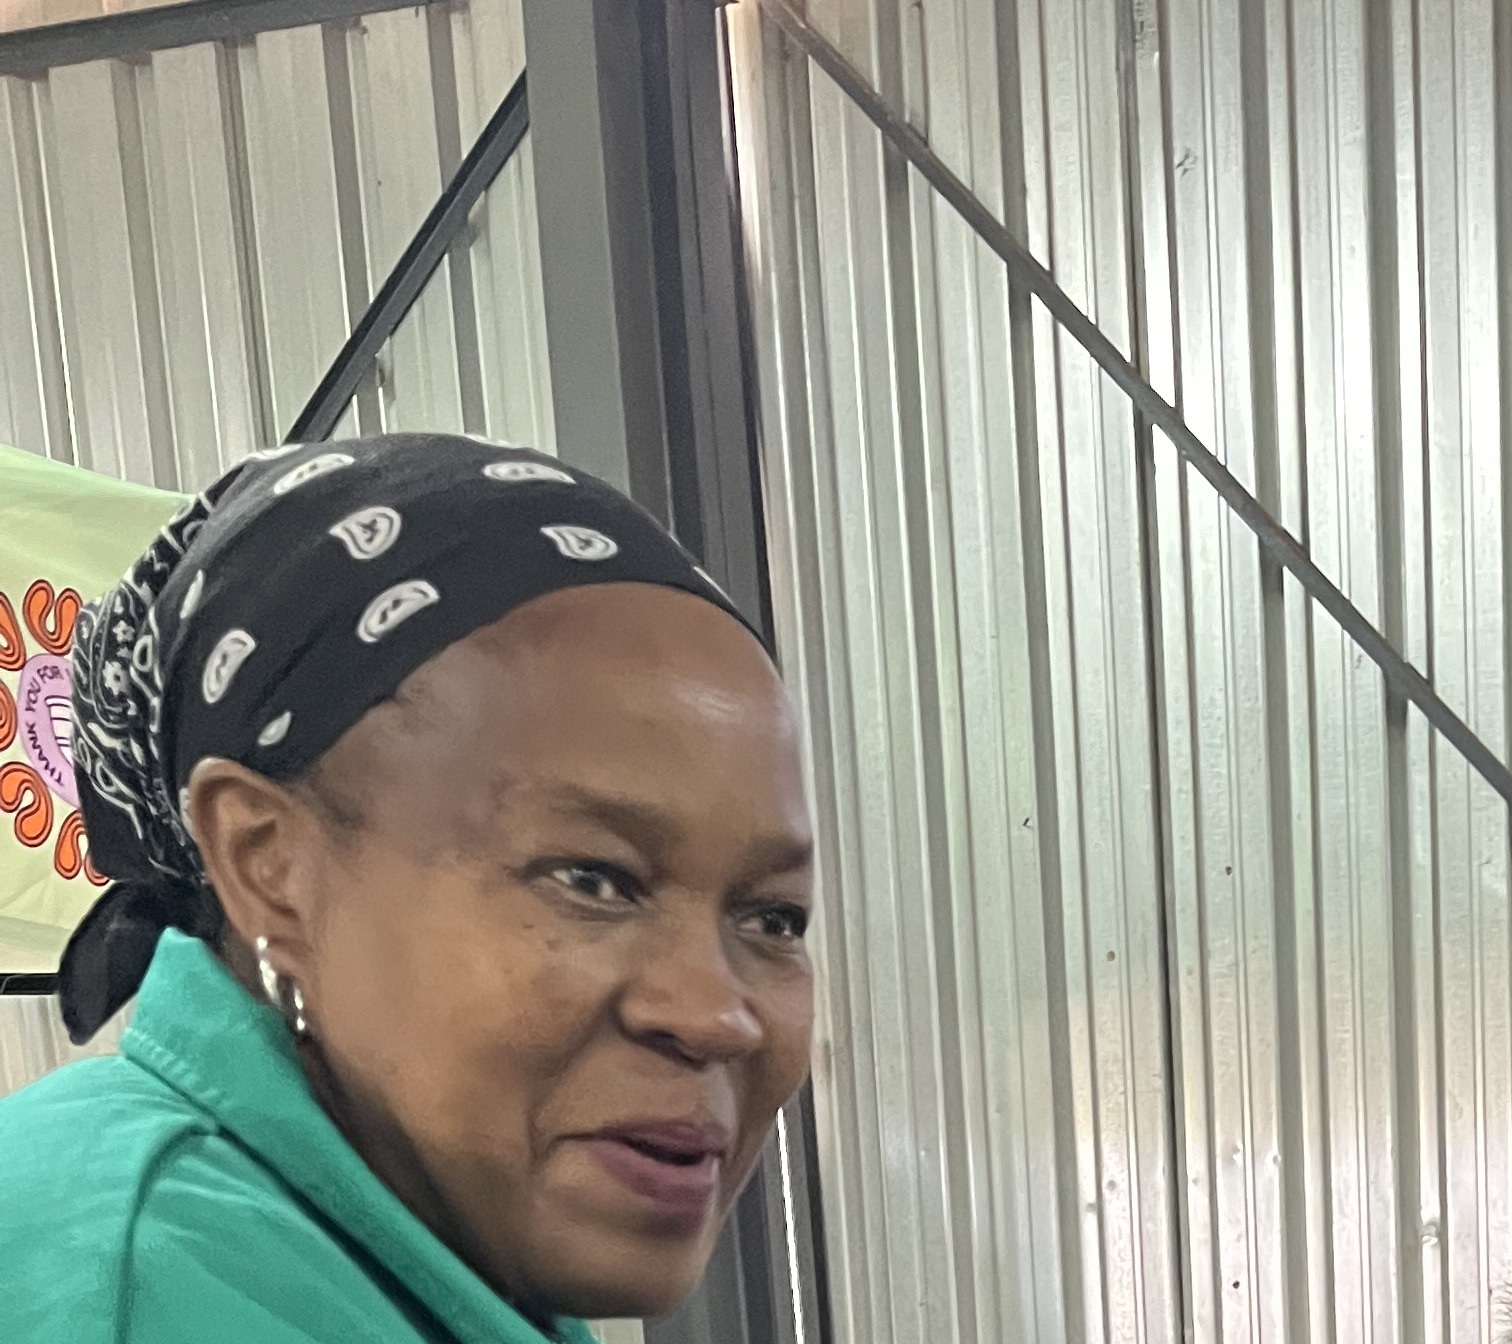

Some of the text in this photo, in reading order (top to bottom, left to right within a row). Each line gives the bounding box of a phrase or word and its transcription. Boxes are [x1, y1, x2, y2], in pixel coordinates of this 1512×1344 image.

[25, 665, 65, 787] THANK YOU FOR
